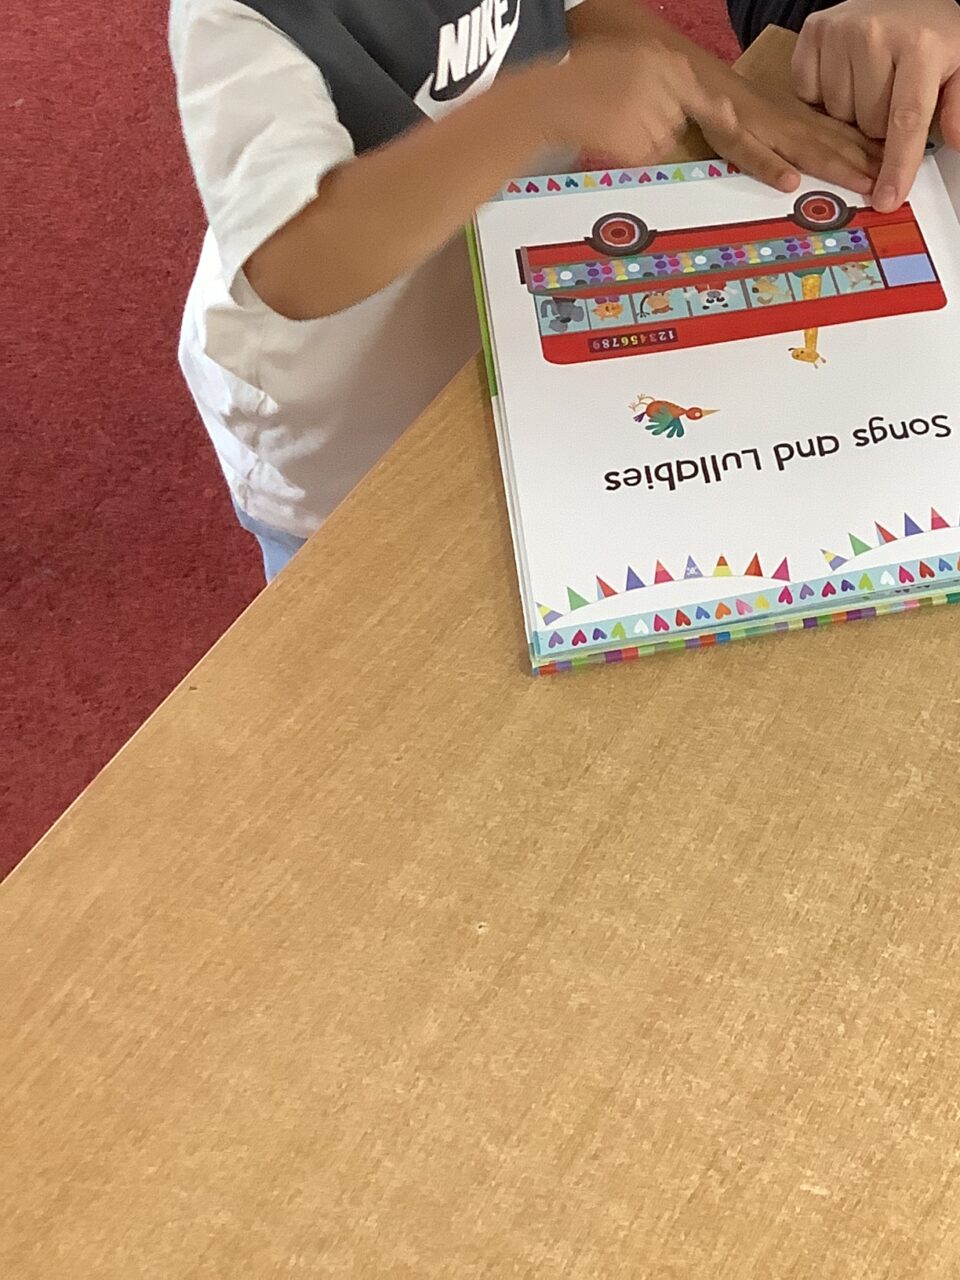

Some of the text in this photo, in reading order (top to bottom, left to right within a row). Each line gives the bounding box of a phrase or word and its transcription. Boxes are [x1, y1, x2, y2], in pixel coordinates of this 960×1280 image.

[604, 414, 953, 491] Songs and Lullabies
